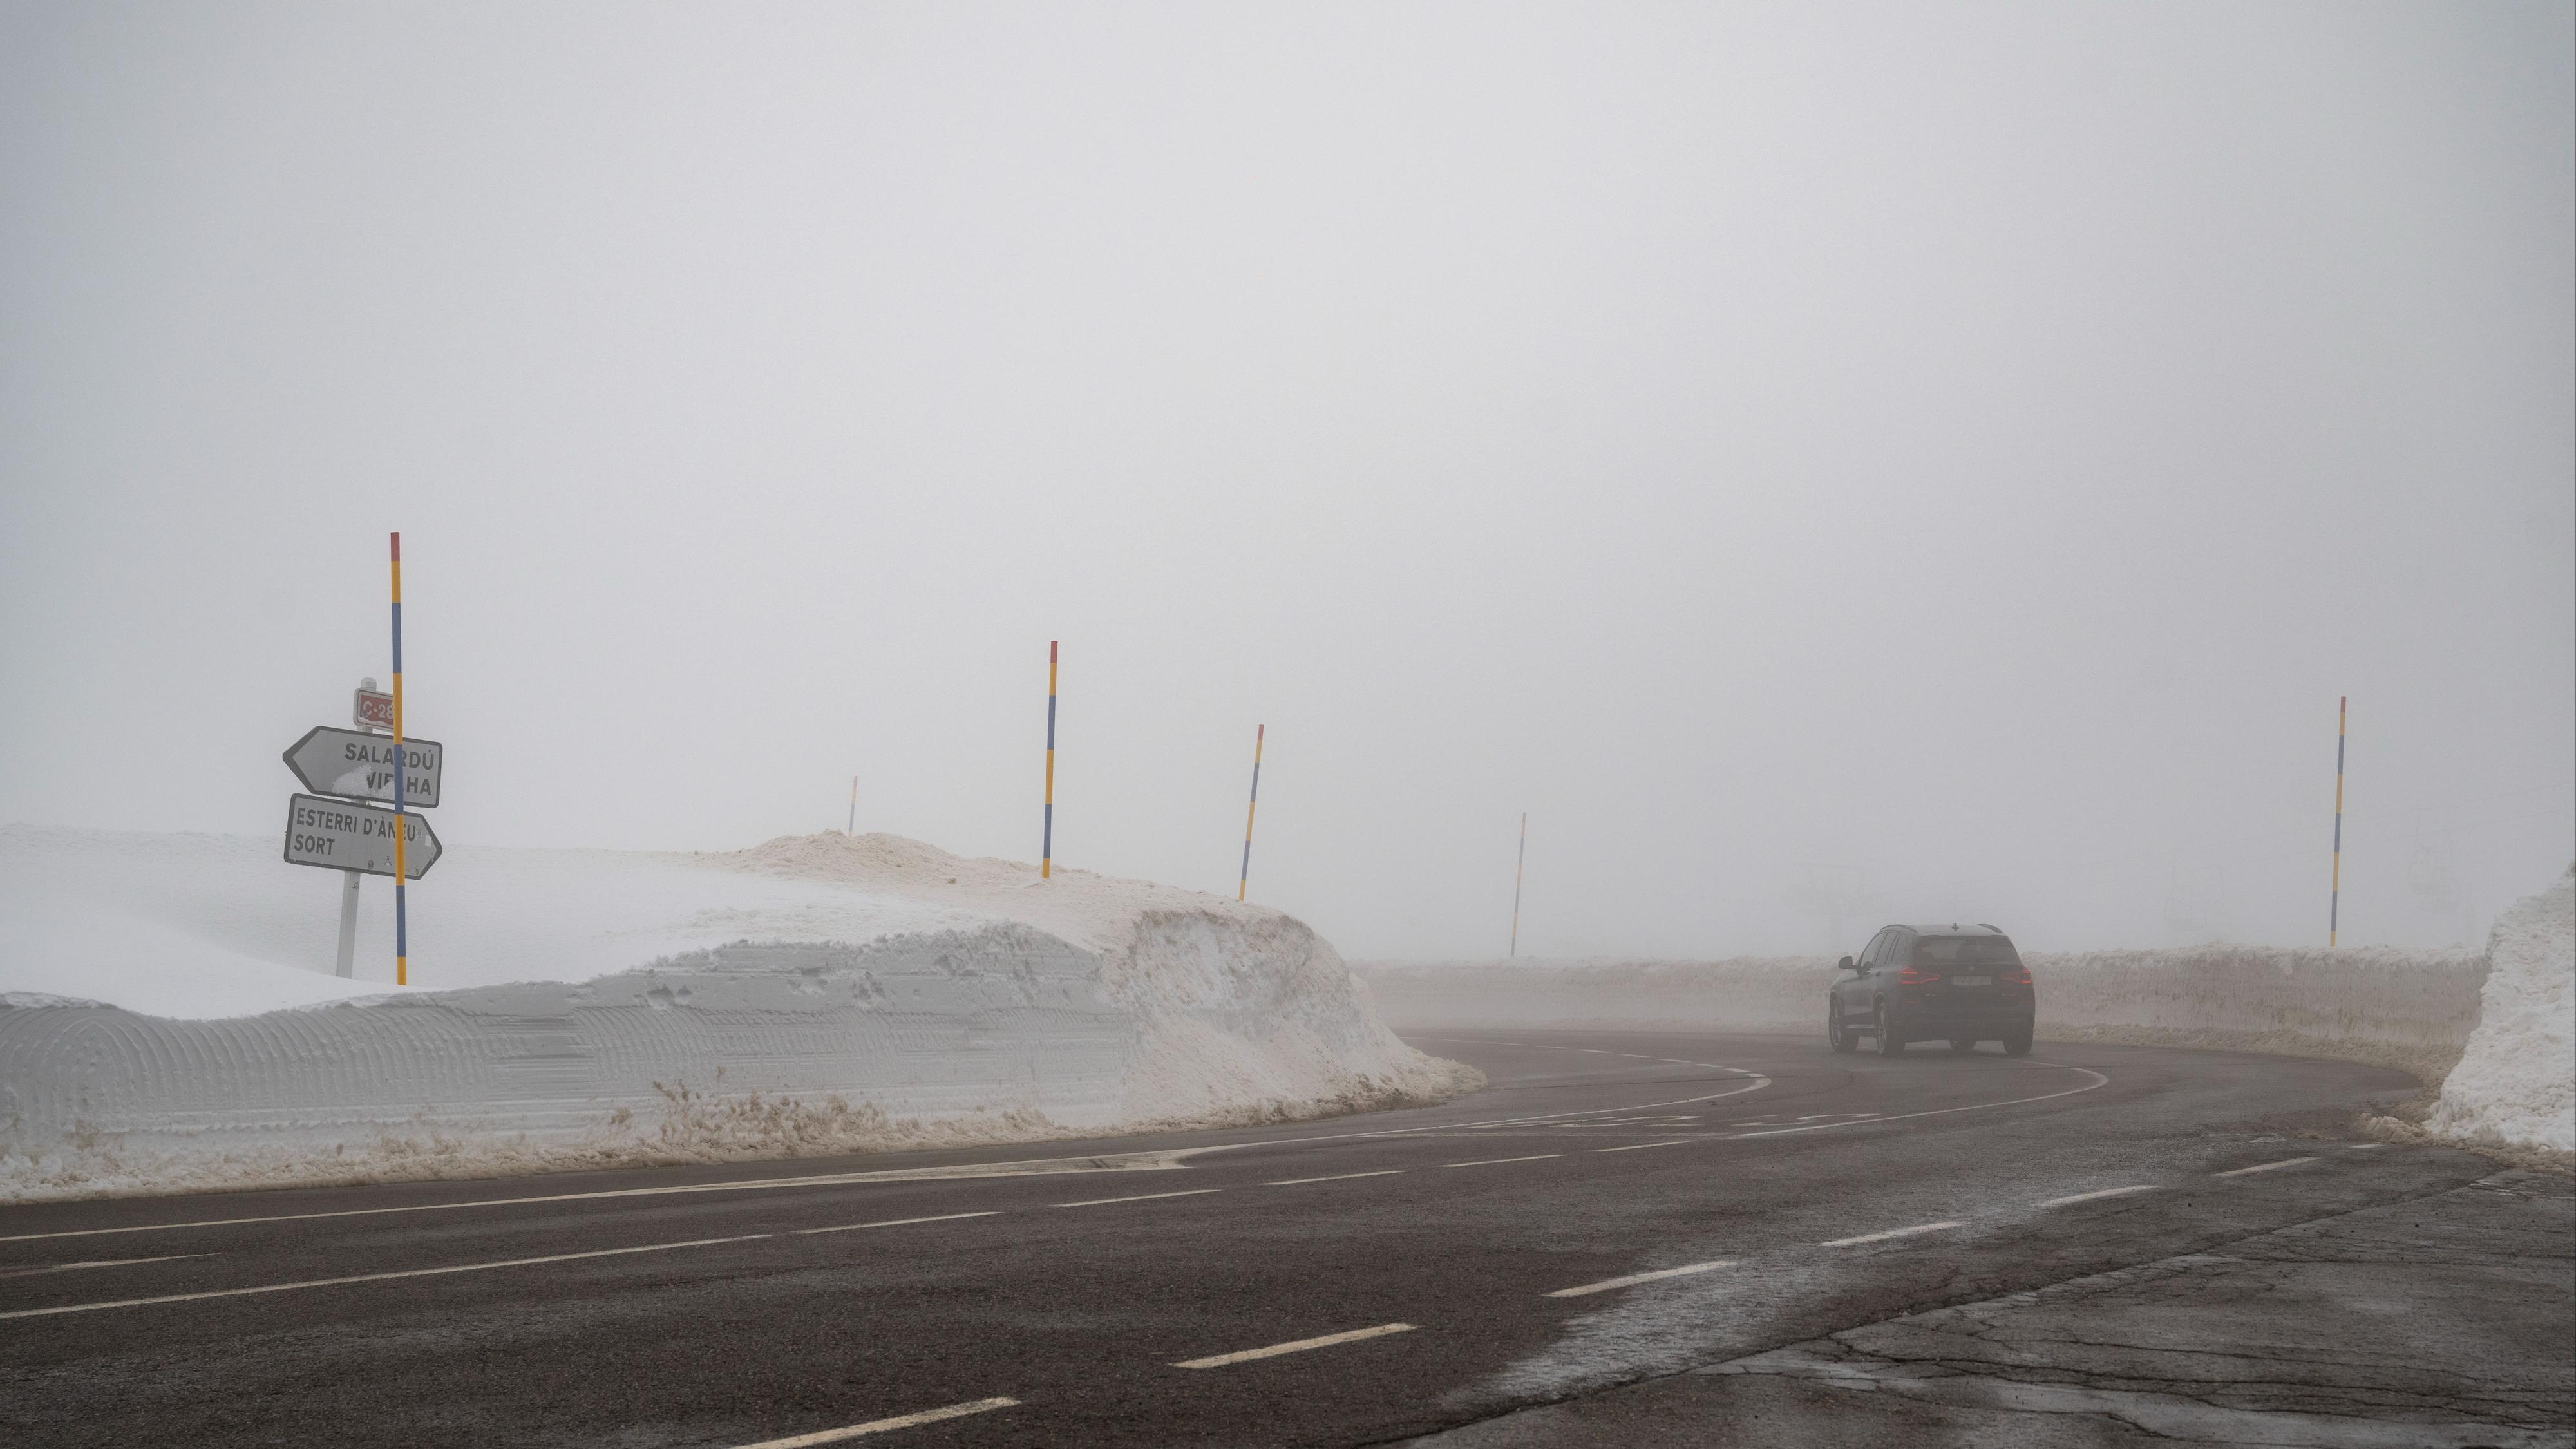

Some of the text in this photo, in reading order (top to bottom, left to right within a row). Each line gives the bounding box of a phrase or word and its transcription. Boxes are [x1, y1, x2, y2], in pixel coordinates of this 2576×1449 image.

[363, 701, 393, 720] C-28
[367, 772, 431, 796] VIHA
[296, 807, 416, 841] ESTERRI D'ÀNU
[294, 833, 335, 855] SORT
[1465, 1113, 1880, 1128] STOP
